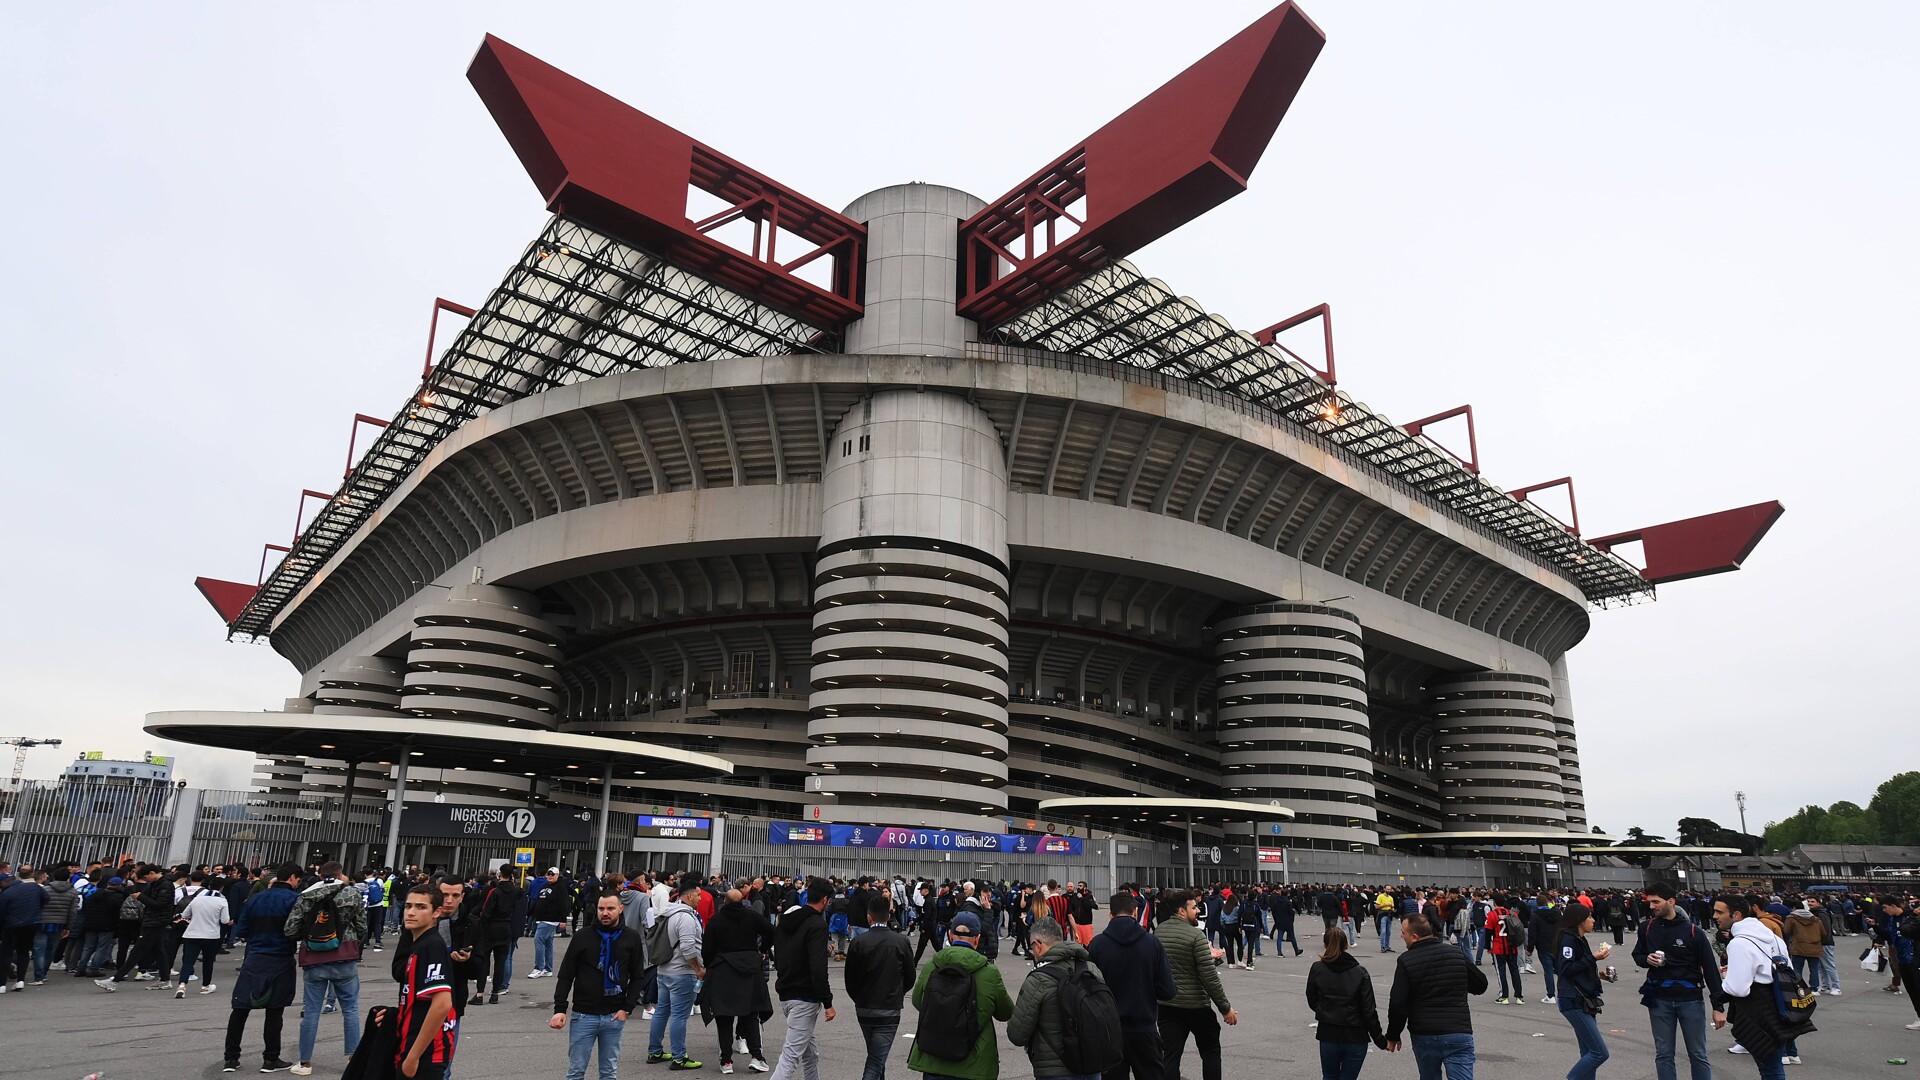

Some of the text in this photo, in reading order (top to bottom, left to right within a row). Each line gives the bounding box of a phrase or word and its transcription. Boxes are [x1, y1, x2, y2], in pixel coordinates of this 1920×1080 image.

[450, 808, 531, 834] INGRESSO 12
[652, 818, 697, 828] INGRESSO APERTO
[463, 822, 490, 834] GATE
[660, 828, 687, 837] GATE OPEN
[889, 832, 928, 845] ROAD
[933, 834, 950, 846] TO
[1212, 848, 1220, 862] 13
